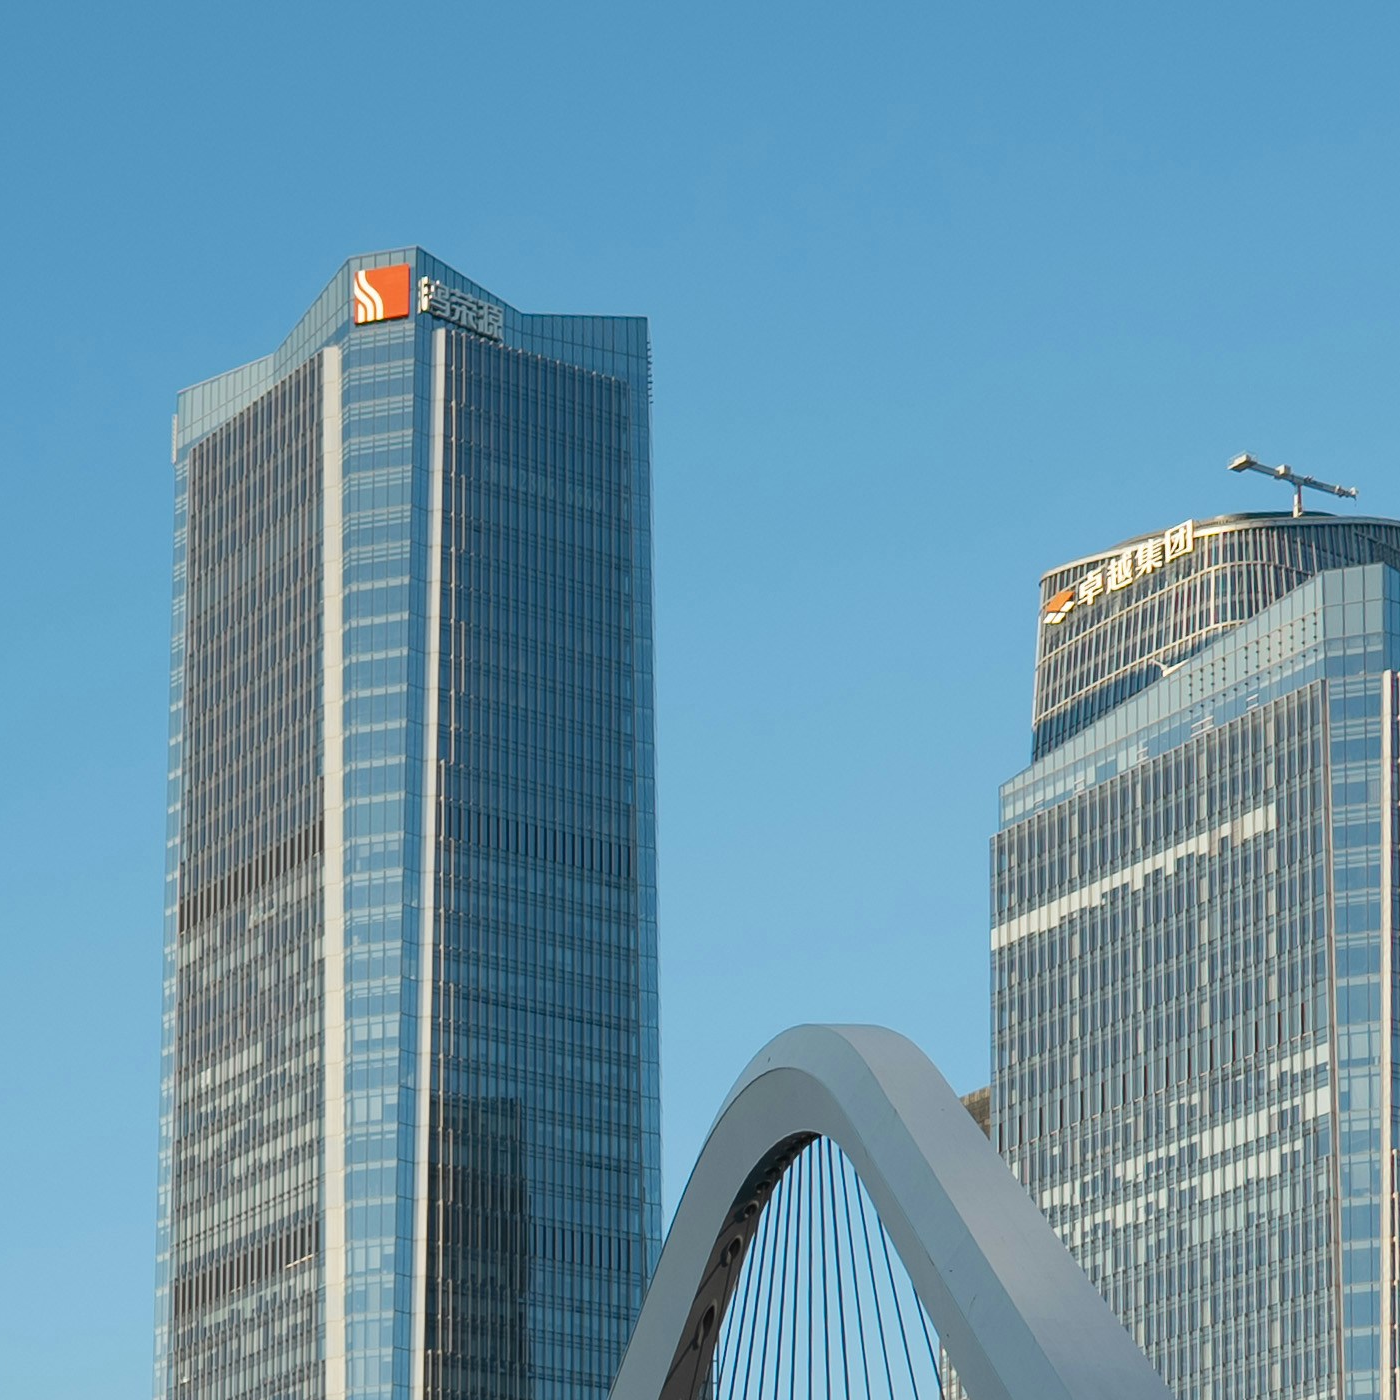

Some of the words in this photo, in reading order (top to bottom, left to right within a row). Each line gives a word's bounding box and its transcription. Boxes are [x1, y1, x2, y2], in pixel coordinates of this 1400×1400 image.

[417, 275, 506, 341] 鸿荣源
[1077, 519, 1194, 606] 卓越集团
